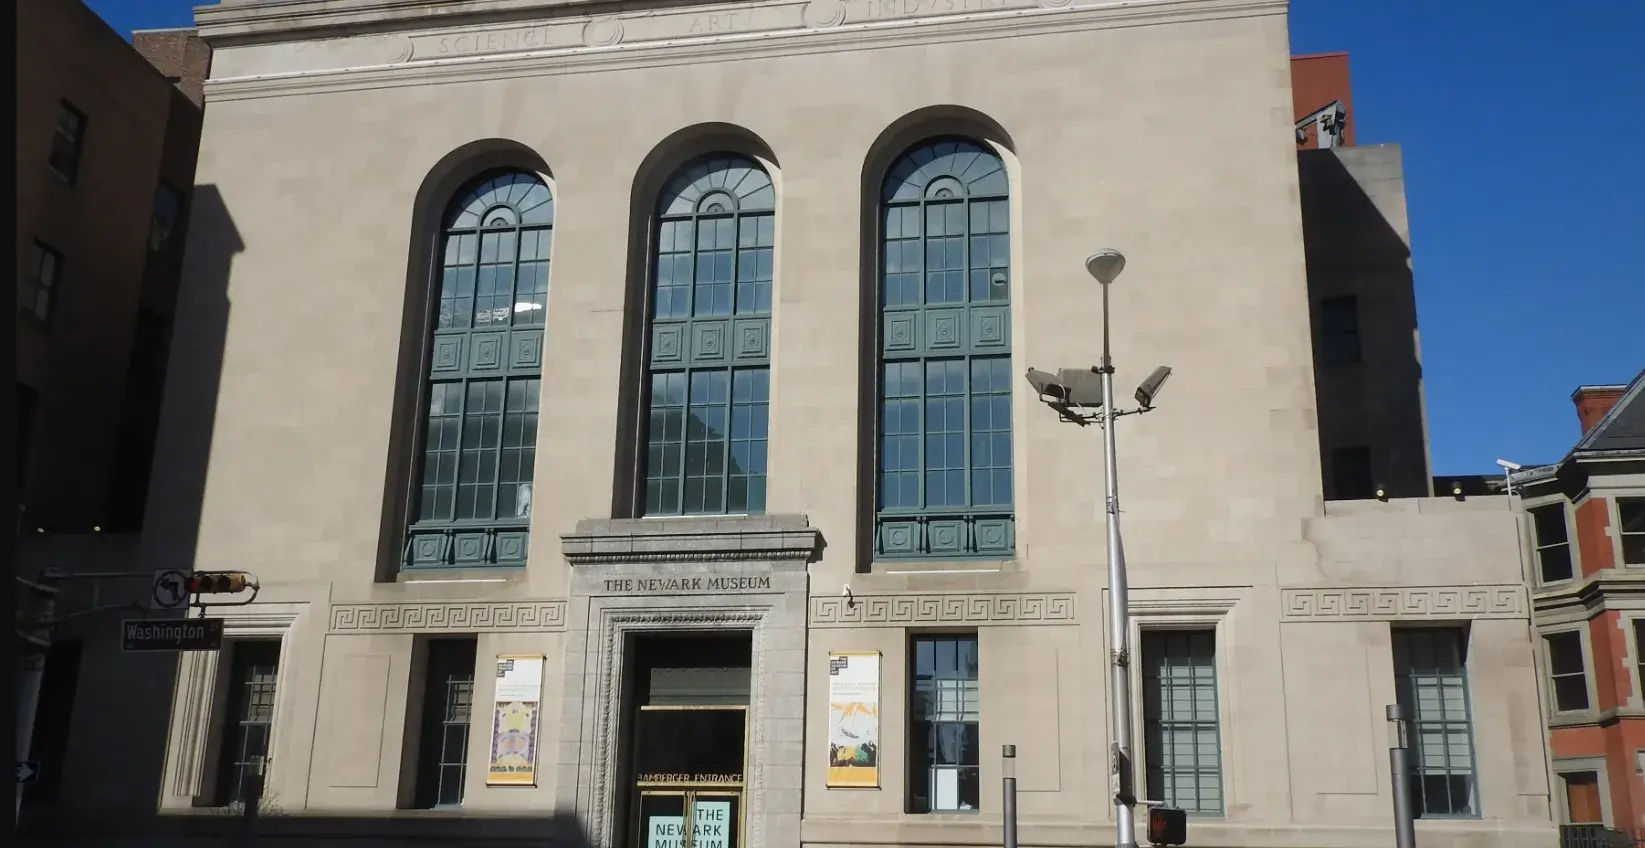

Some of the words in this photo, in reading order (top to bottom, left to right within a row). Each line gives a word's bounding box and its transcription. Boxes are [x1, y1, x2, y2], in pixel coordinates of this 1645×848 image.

[689, 12, 739, 33] ART
[440, 28, 553, 53] SCIENCE
[604, 579, 633, 592] THE
[637, 577, 702, 591] NEWARK
[706, 576, 772, 590] MUSEUM
[127, 624, 204, 644] Washington
[694, 773, 743, 783] ENTRANCE
[697, 808, 724, 821] THE
